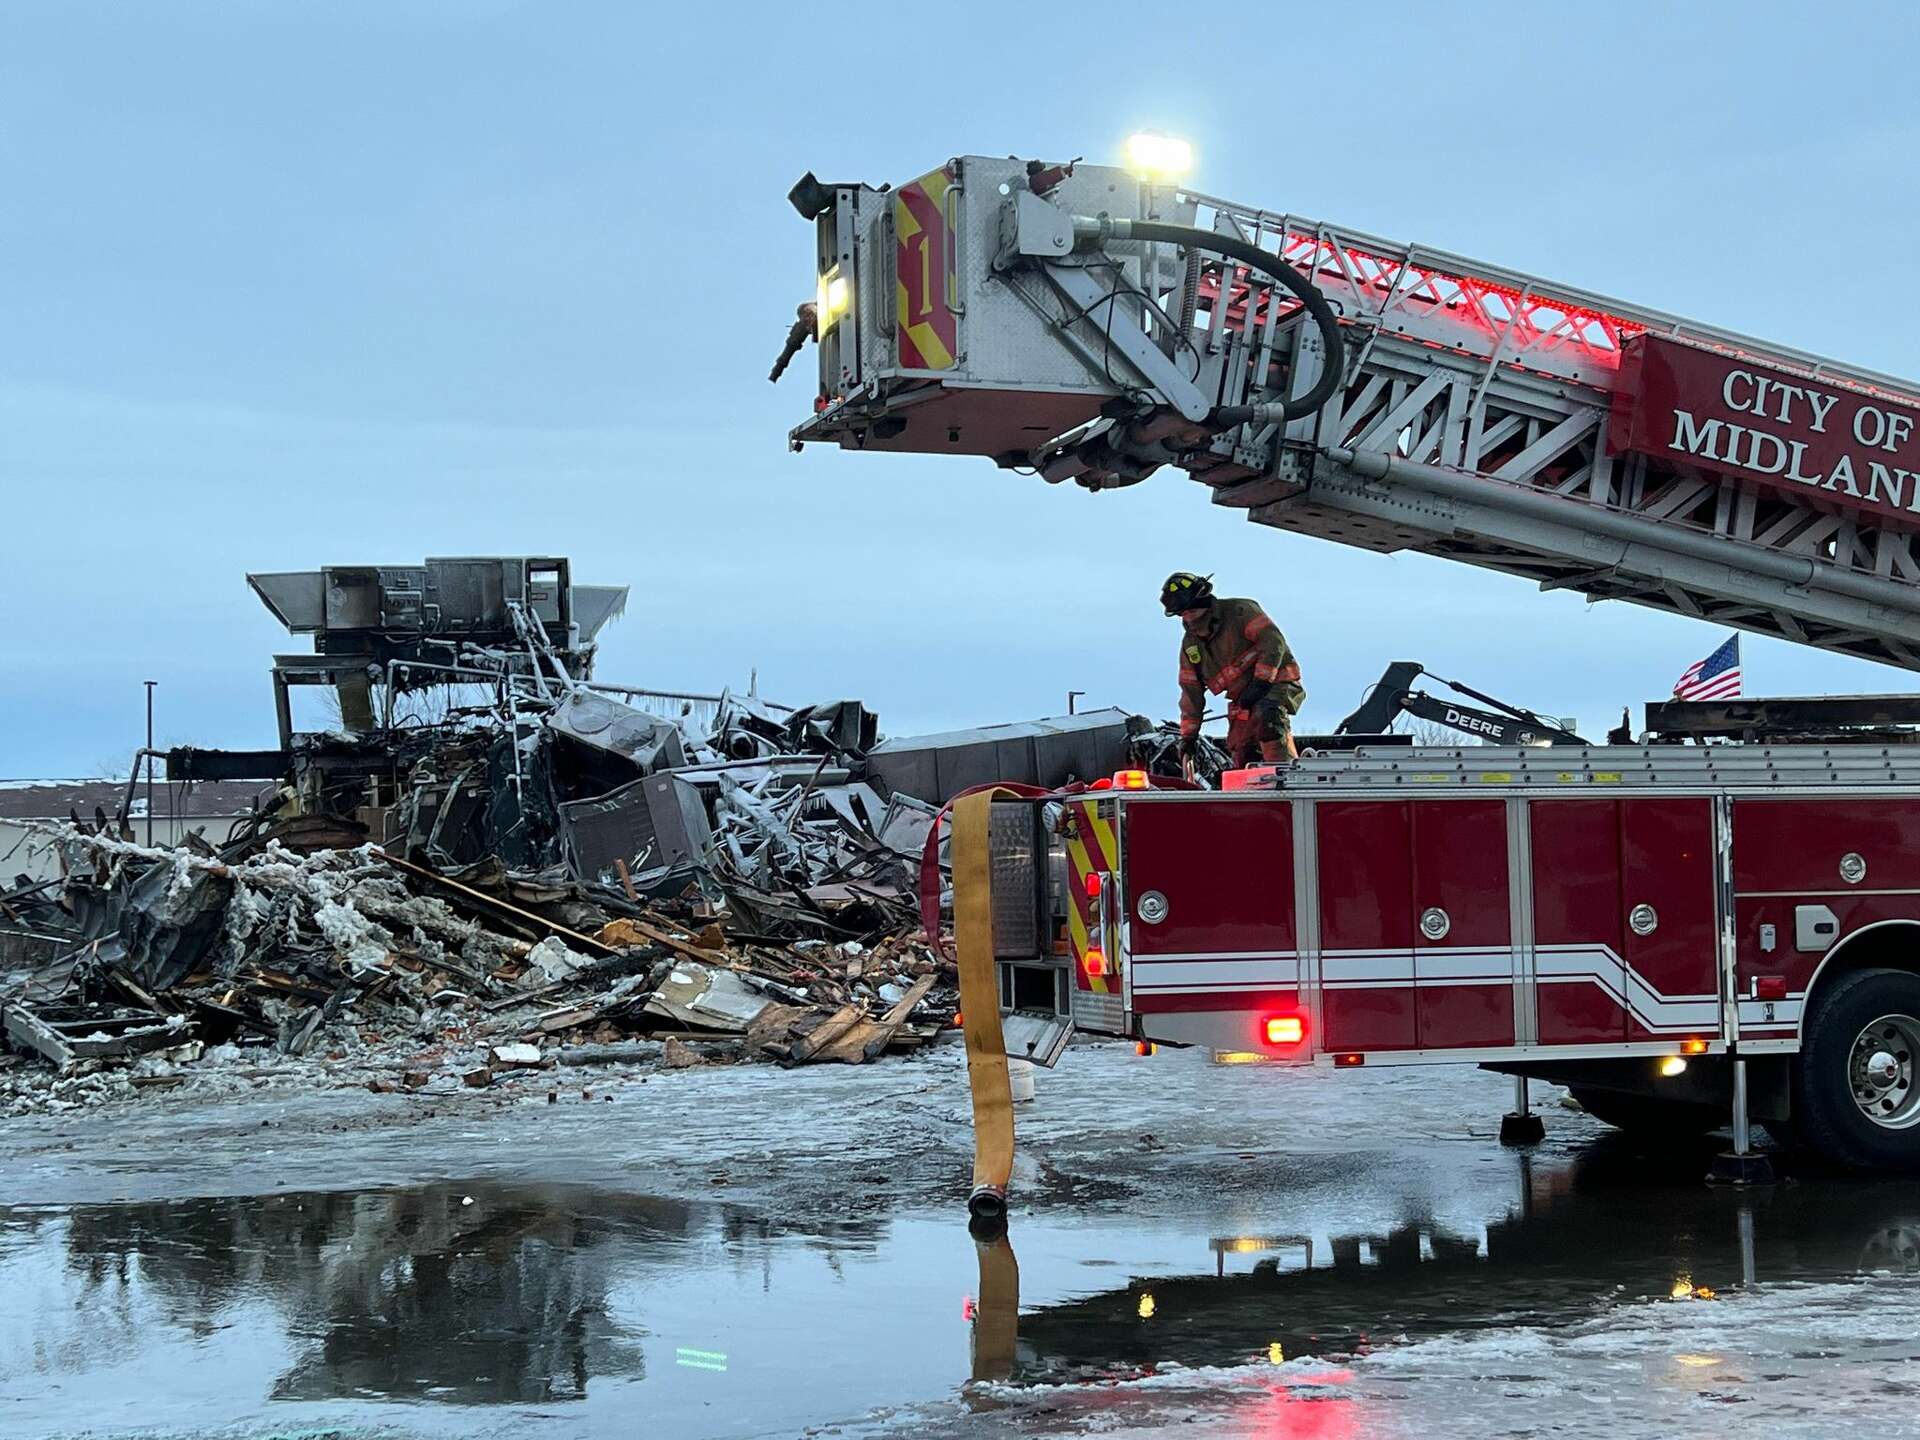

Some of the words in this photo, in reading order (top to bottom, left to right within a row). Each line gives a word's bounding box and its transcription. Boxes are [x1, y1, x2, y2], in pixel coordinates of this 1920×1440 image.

[919, 235, 933, 317] 1
[1722, 369, 1839, 433] CITY
[1853, 406, 1914, 452] OF
[1668, 409, 1920, 513] MIDLAN
[1445, 708, 1504, 738] DEERE
